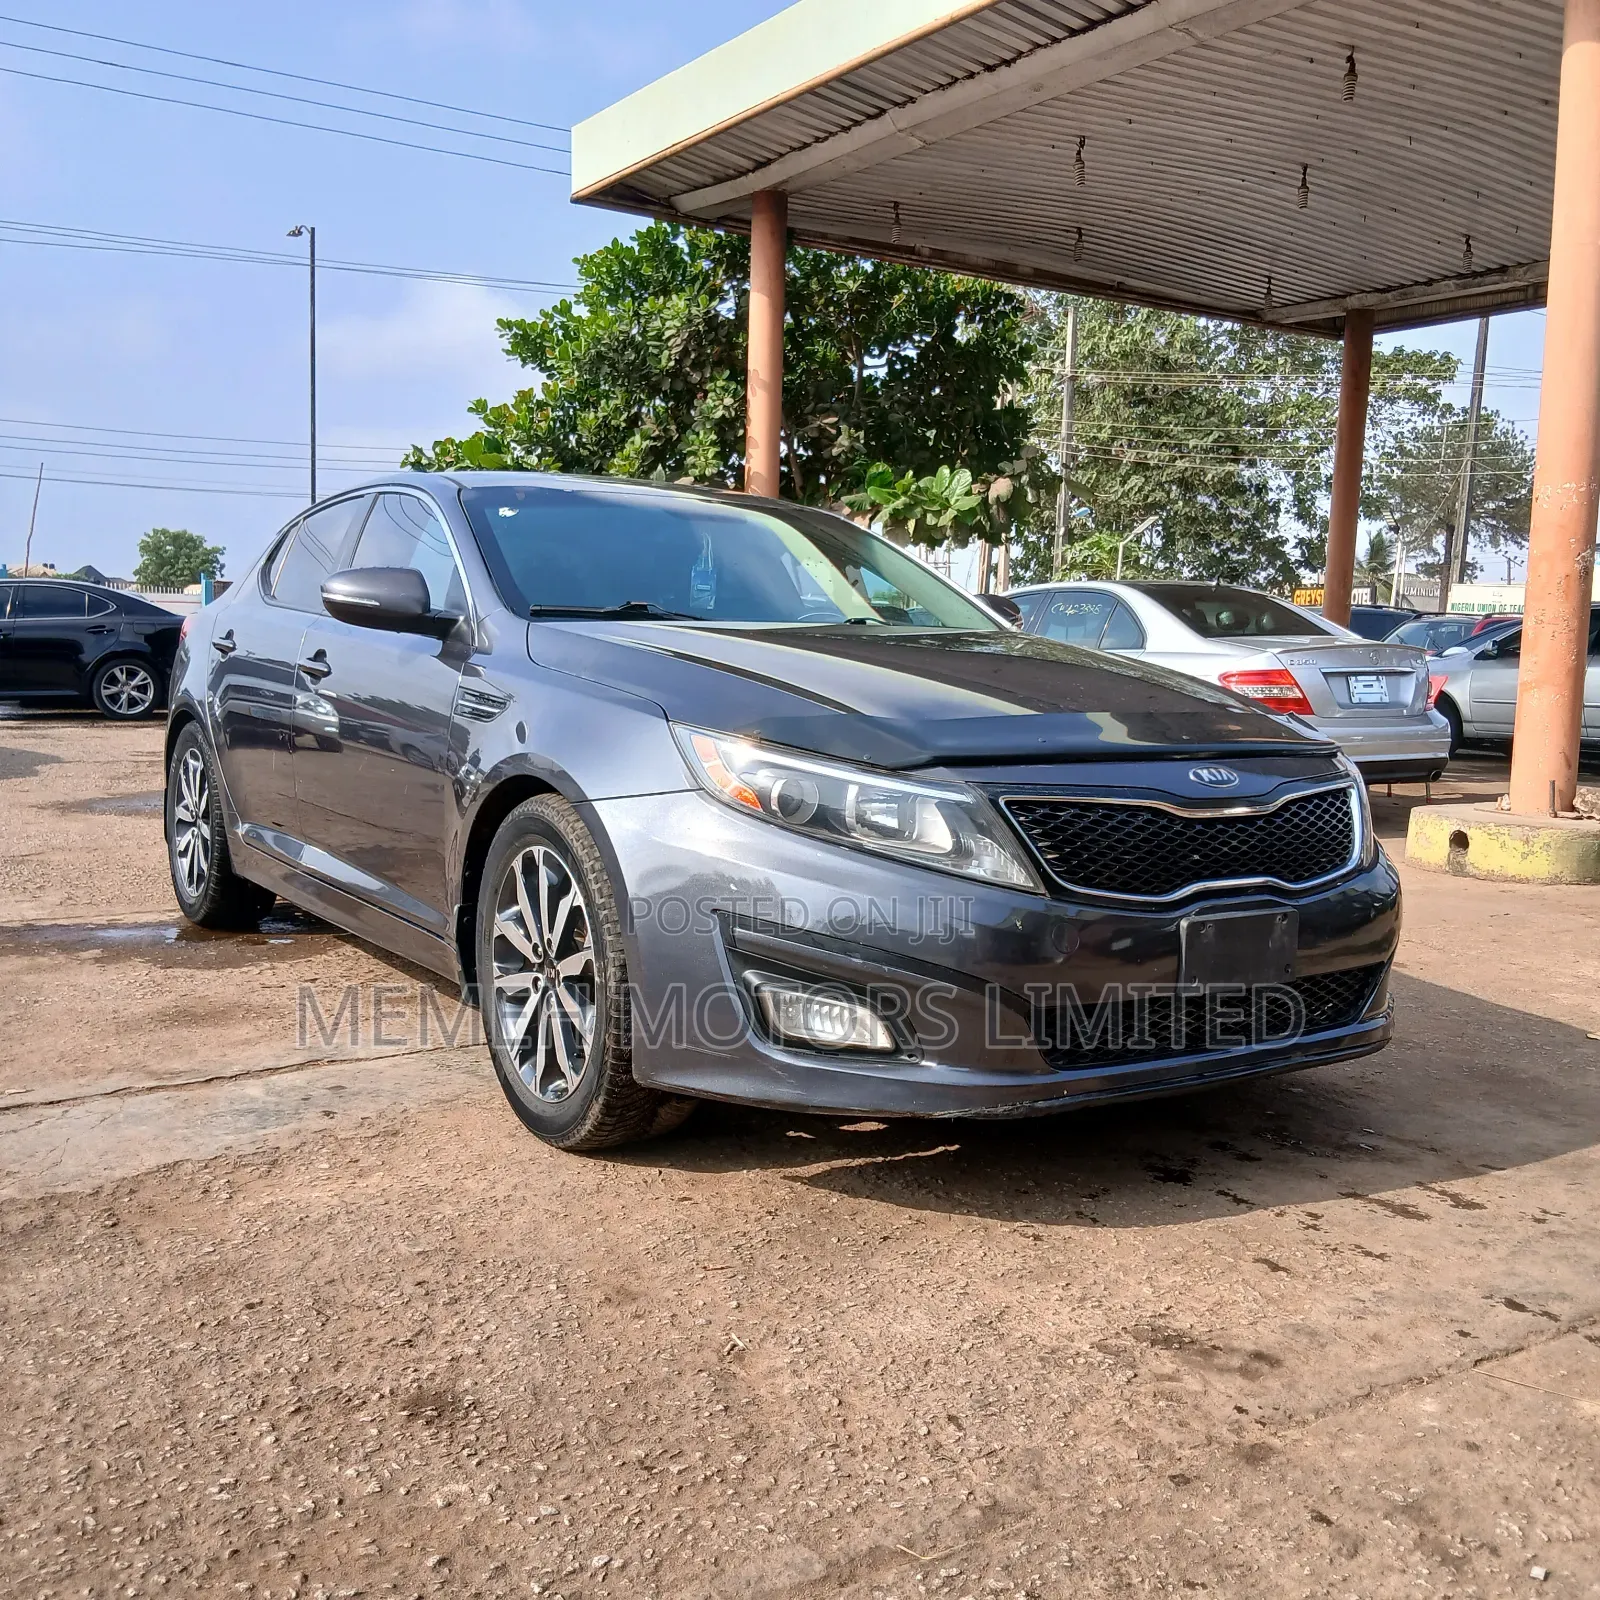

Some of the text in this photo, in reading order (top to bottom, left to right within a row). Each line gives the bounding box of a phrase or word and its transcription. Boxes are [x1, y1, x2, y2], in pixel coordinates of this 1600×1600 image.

[1294, 587, 1371, 605] GREYST OTEL
[1404, 586, 1440, 597] UMINIUM
[1450, 602, 1524, 613] NIGERIA UNION OF TEAC
[1195, 767, 1236, 782] KIA
